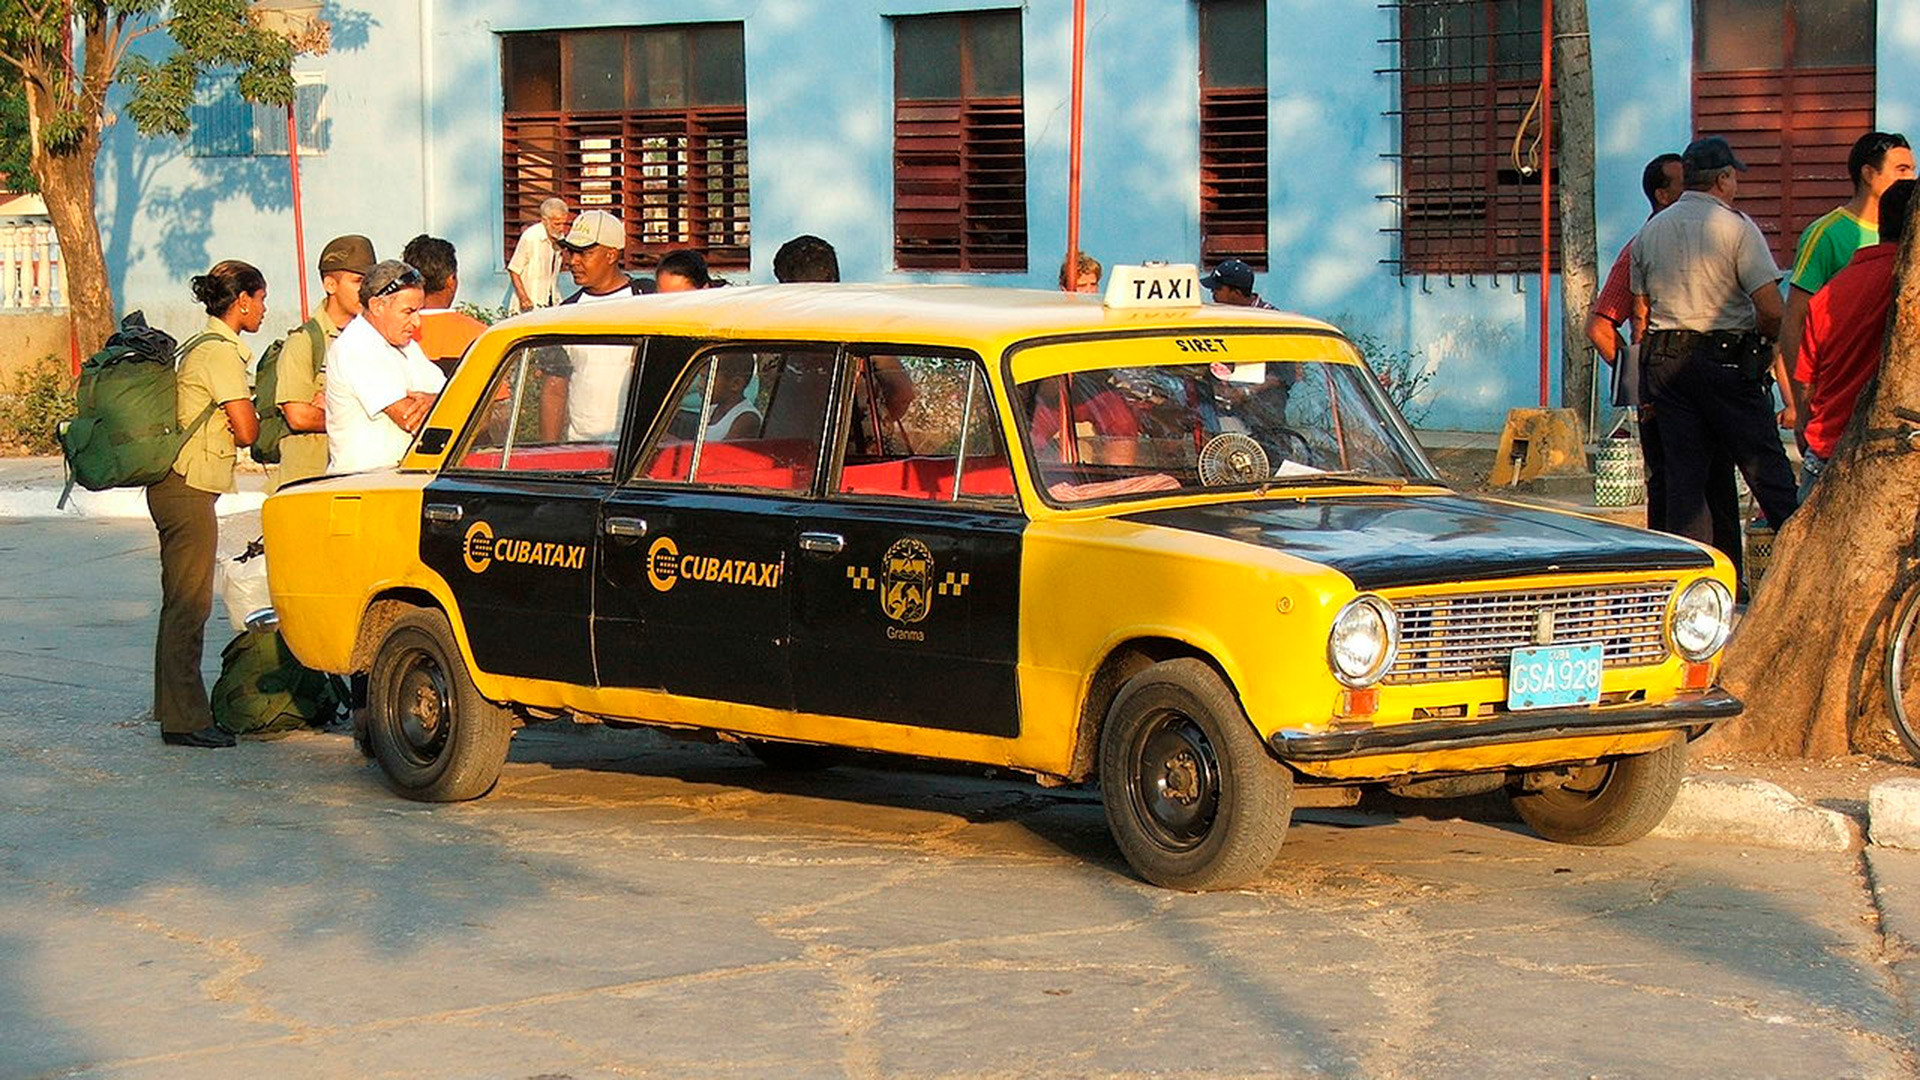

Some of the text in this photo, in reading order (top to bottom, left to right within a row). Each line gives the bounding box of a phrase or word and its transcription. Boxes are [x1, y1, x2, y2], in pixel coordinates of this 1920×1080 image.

[1133, 278, 1192, 299] TAXI
[1175, 338, 1229, 353] SIRET
[494, 537, 587, 570] CUBATAXI
[679, 554, 781, 589] CUBATAXI
[886, 625, 925, 641] Granma
